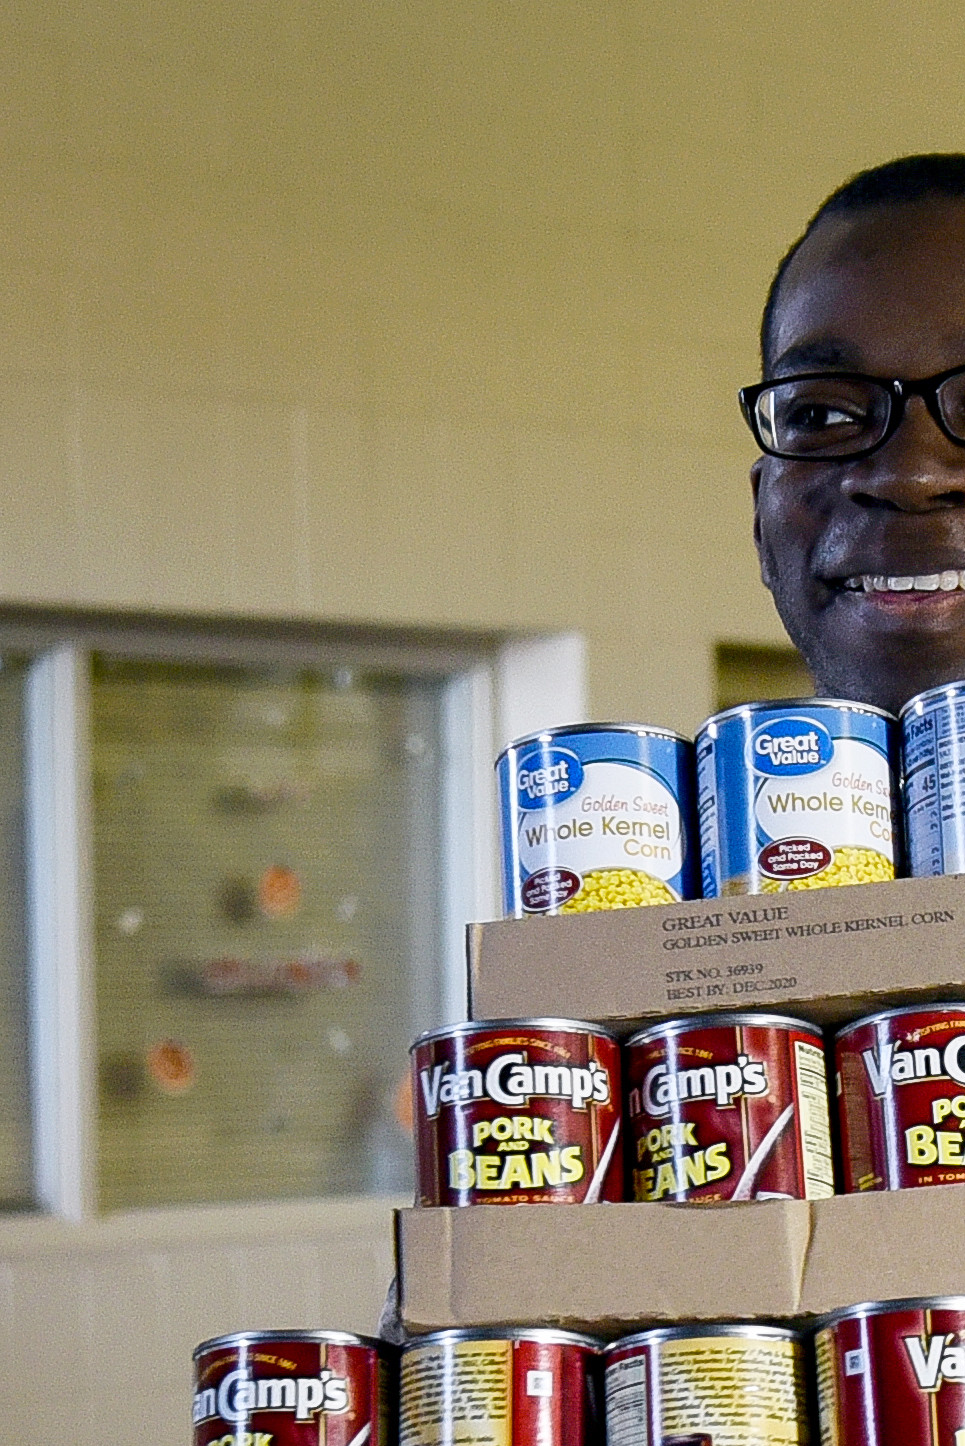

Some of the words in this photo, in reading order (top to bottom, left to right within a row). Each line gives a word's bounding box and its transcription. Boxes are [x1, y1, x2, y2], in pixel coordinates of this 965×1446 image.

[755, 731, 819, 755] Great
[770, 750, 819, 766] Value
[518, 760, 569, 790] Great
[832, 771, 873, 793] Golden
[527, 780, 569, 799] Value
[581, 795, 628, 813] Golden
[632, 796, 669, 817] Sweet
[768, 792, 843, 814] Whole
[852, 794, 890, 822] Kern
[525, 818, 593, 848] Whole
[602, 816, 670, 841] Kernel
[870, 820, 891, 842] Co
[623, 839, 672, 861] Corn
[768, 854, 787, 864] and
[788, 851, 824, 862] Packed
[779, 842, 811, 854] Picked
[772, 861, 799, 872] Same
[800, 860, 819, 870] Day
[662, 913, 723, 932] GREAT
[728, 906, 788, 925] VALUE
[662, 932, 728, 951] GOLDEN
[731, 927, 782, 945] SWEET
[785, 921, 842, 939] WHOLE
[844, 915, 906, 932] KERNEL
[911, 910, 955, 925] CORN
[665, 970, 693, 984] STK
[726, 963, 764, 977] 36939
[666, 986, 703, 1001] BEST
[862, 1043, 941, 1095] Van
[420, 1064, 484, 1117] Van
[486, 1051, 609, 1109] Camp's
[643, 1055, 768, 1117] Camp's
[473, 1117, 555, 1147] PORK
[637, 1122, 698, 1162] PORK
[497, 1141, 530, 1152] AND
[449, 1146, 584, 1190] BEANS
[918, 1175, 933, 1184] IN
[218, 1369, 349, 1422] Camp's
